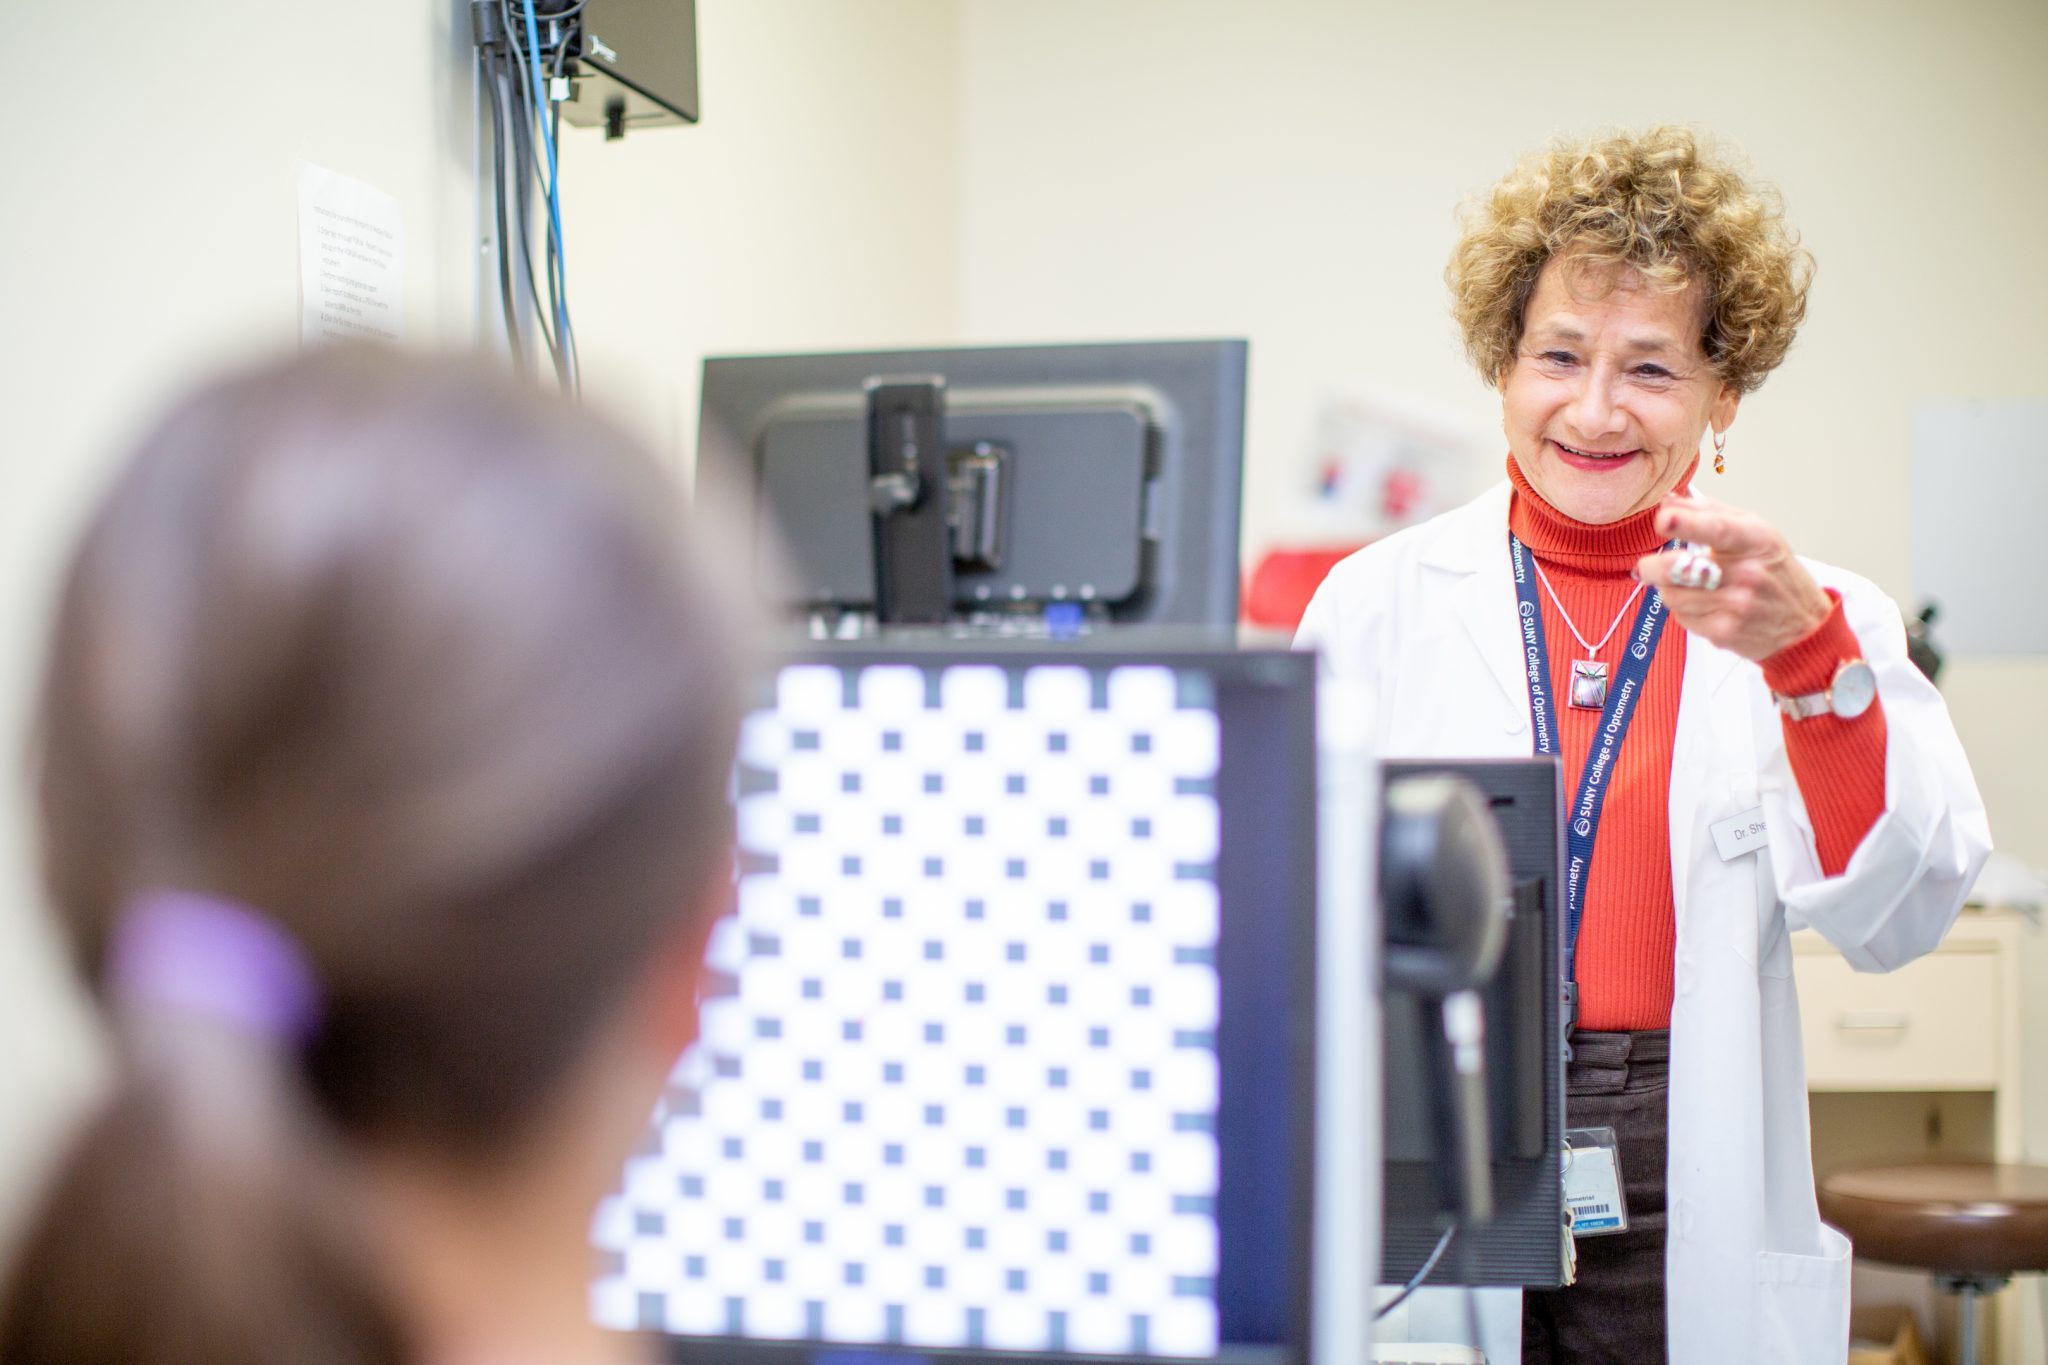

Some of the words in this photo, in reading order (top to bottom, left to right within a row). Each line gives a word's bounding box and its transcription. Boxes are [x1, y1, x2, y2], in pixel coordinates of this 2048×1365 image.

[1523, 617, 1537, 645] SUNY
[1638, 615, 1656, 643] SUNY
[1649, 591, 1664, 615] Coll
[1527, 646, 1540, 683] College
[1532, 685, 1544, 696] of
[1606, 678, 1636, 733] Optometry
[1533, 697, 1550, 753] Optometry
[1604, 733, 1614, 746] of
[1589, 746, 1610, 785] College
[1580, 786, 1597, 817] SUNY
[1749, 822, 1767, 835] She
[1569, 856, 1584, 910] ptometry
